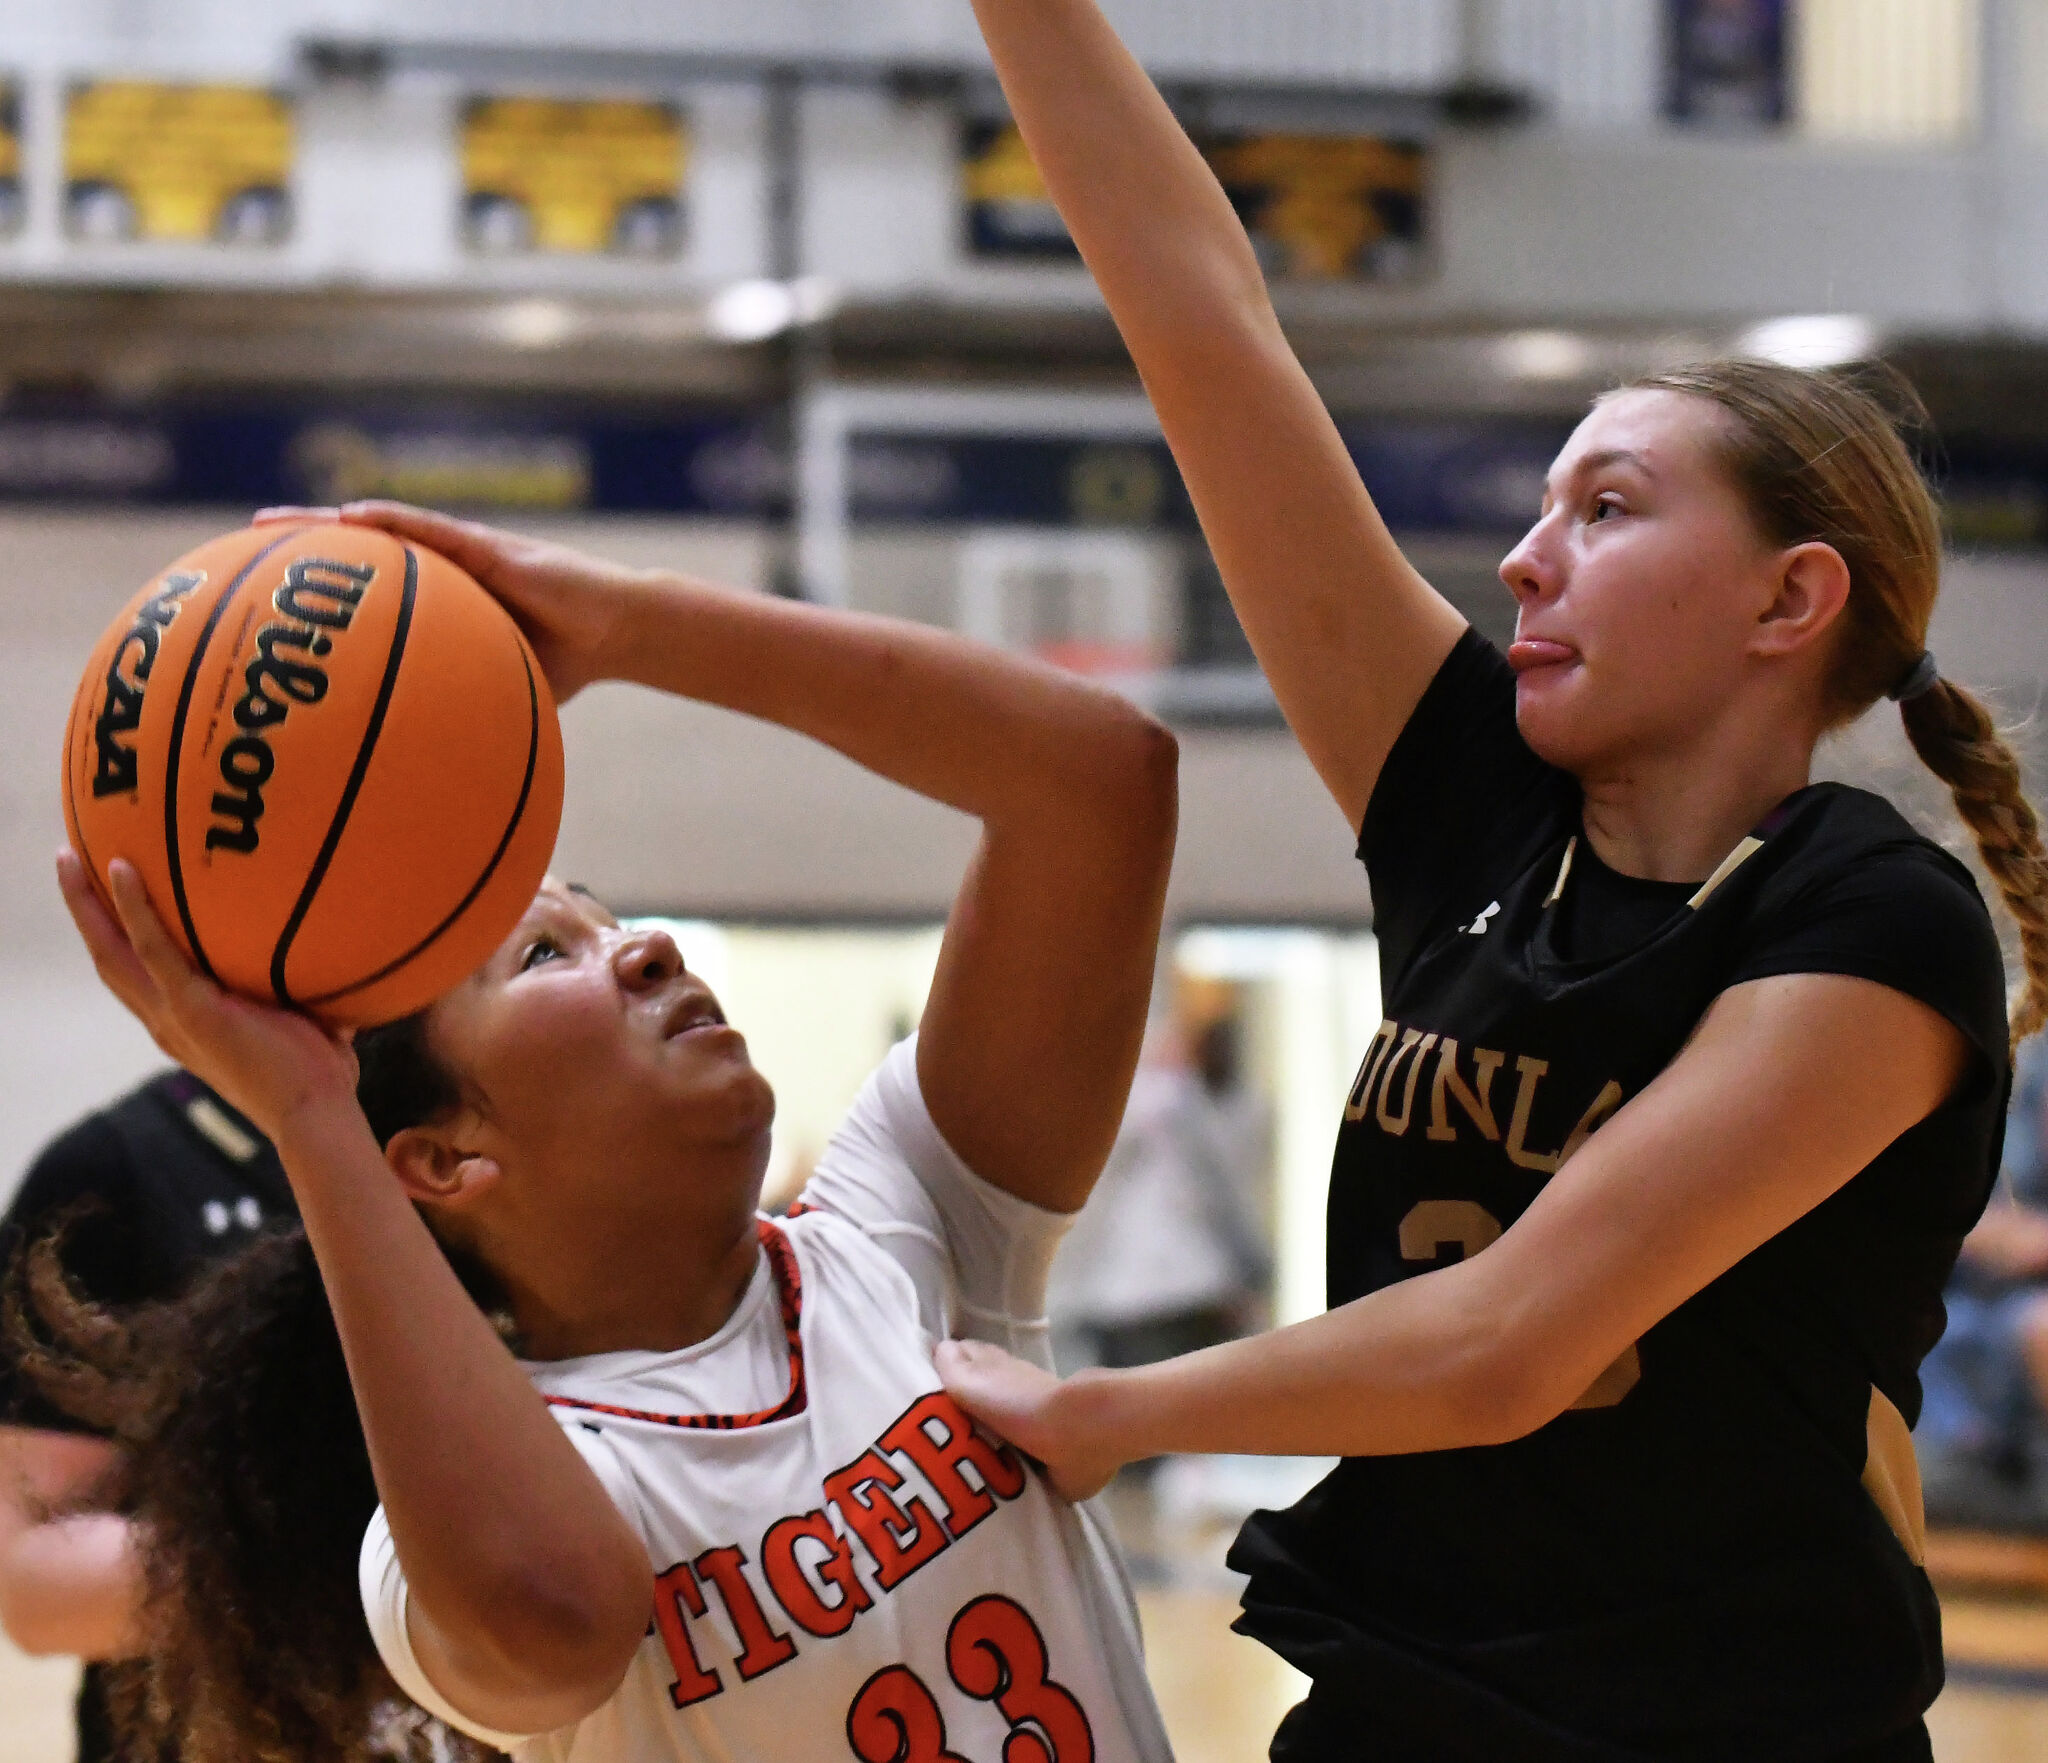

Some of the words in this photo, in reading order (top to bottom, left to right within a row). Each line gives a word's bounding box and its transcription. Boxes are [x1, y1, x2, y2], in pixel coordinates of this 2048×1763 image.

[93, 568, 208, 800] NCAA
[205, 556, 379, 854] Wilson
[654, 1390, 1027, 1710] TIGER
